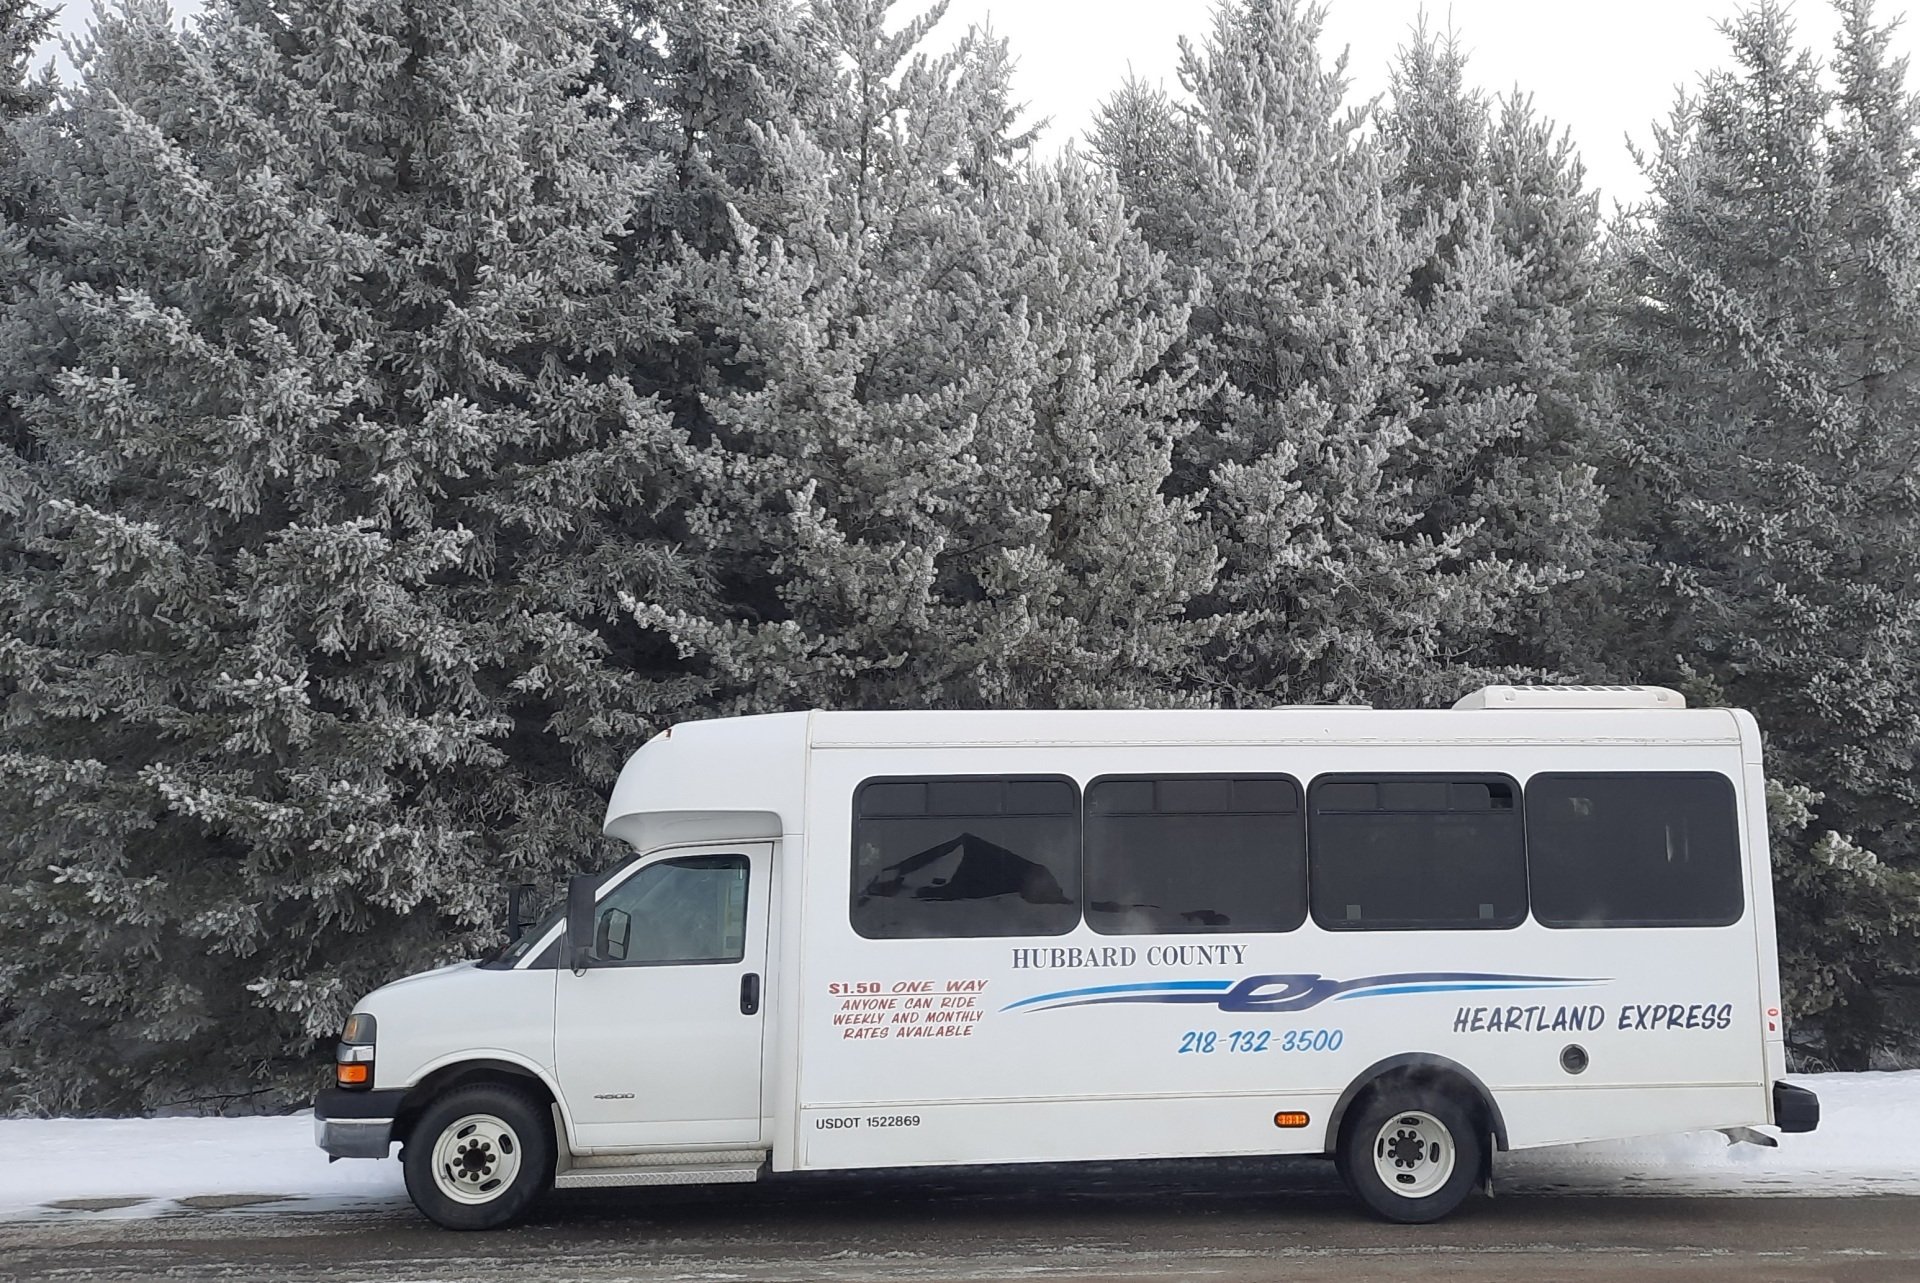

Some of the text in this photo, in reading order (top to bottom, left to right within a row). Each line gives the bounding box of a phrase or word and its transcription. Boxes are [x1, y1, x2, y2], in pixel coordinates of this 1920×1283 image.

[1011, 944, 1248, 969] HUBBARD COUNTY
[828, 980, 989, 994] $1.50 ONE WAY
[841, 996, 977, 1011] ANYONE CAN RIDE
[833, 1010, 984, 1025] WEEKLY AND MONTHLY
[1452, 1003, 1733, 1033] HEARTLAND EXPRESS
[843, 1025, 973, 1040] RATES AVAILABLE
[1177, 1029, 1344, 1054] 218-732-3500
[816, 1115, 921, 1130] USDOT 1522869
